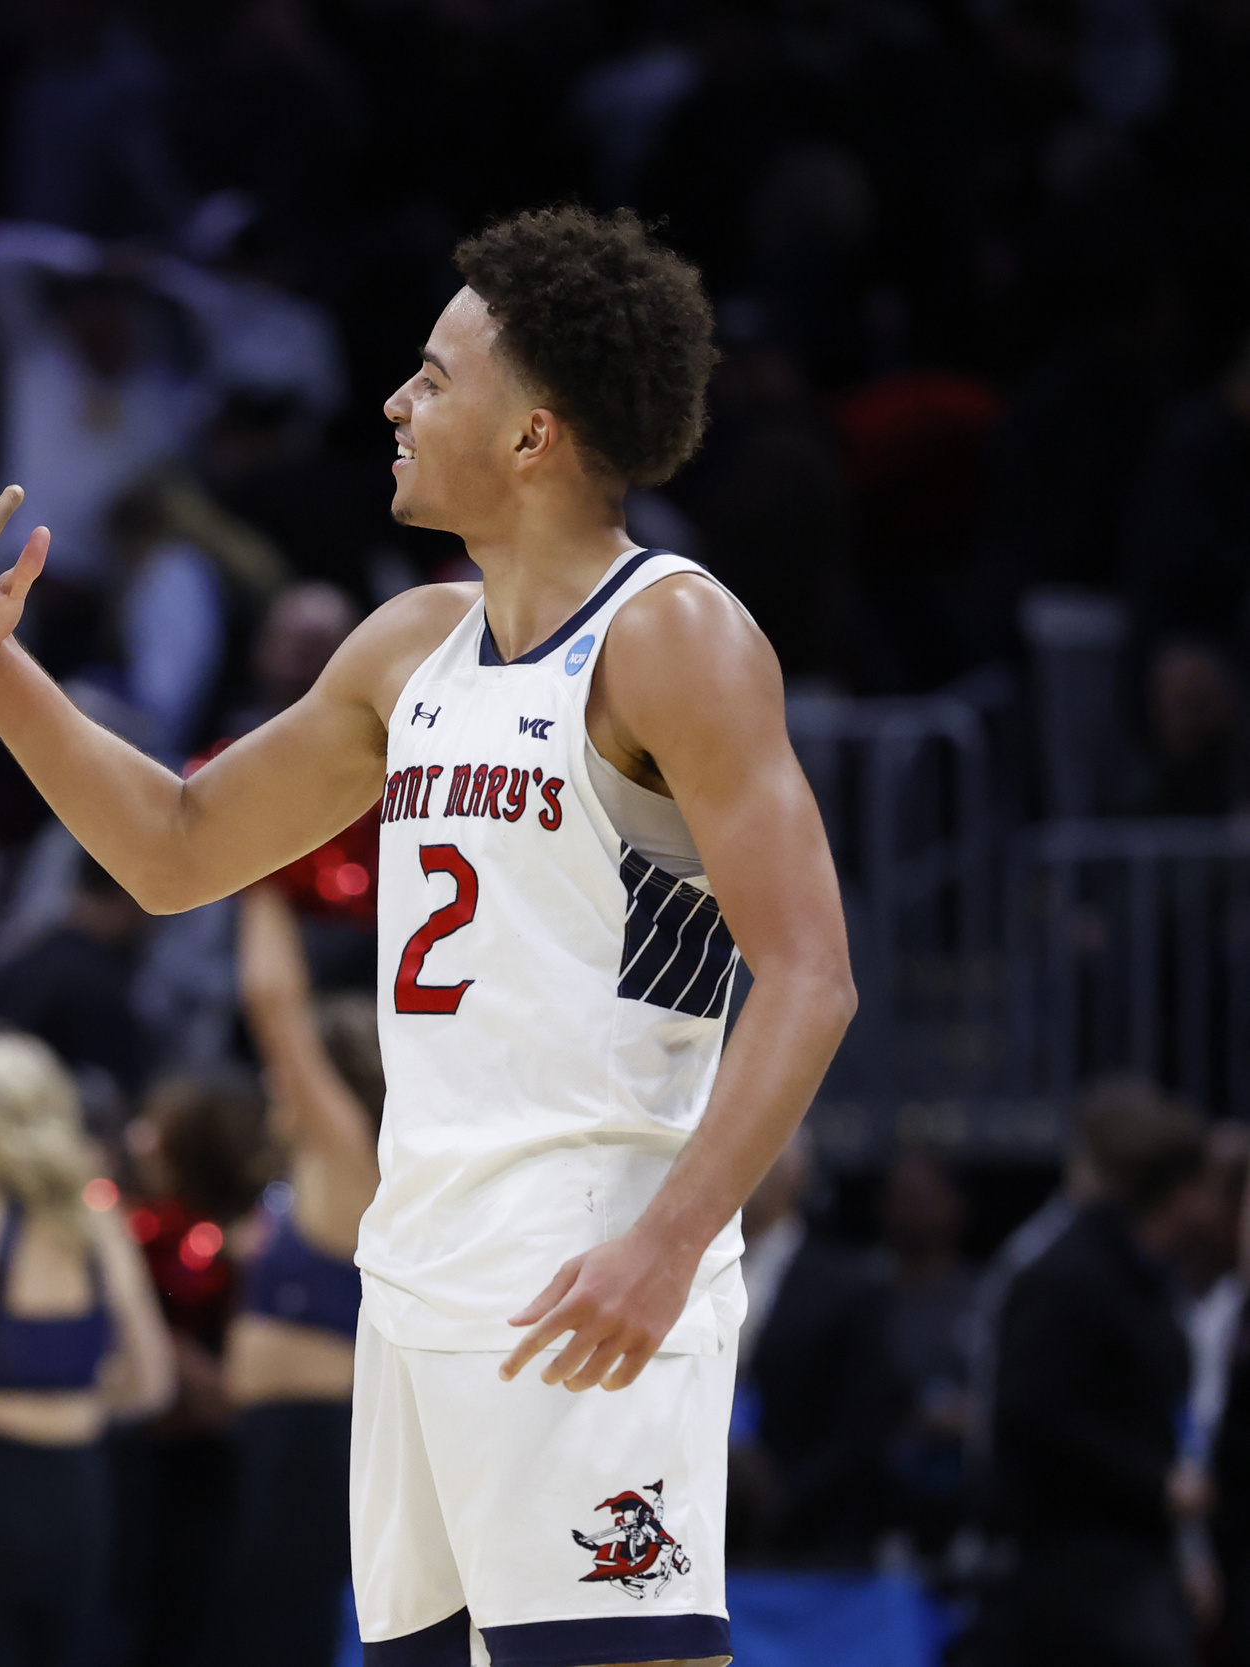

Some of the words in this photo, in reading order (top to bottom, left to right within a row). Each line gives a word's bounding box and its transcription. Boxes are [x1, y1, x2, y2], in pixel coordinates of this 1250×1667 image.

[519, 716, 556, 740] WCC
[443, 764, 565, 831] MARY'S
[394, 844, 478, 1015] 2
